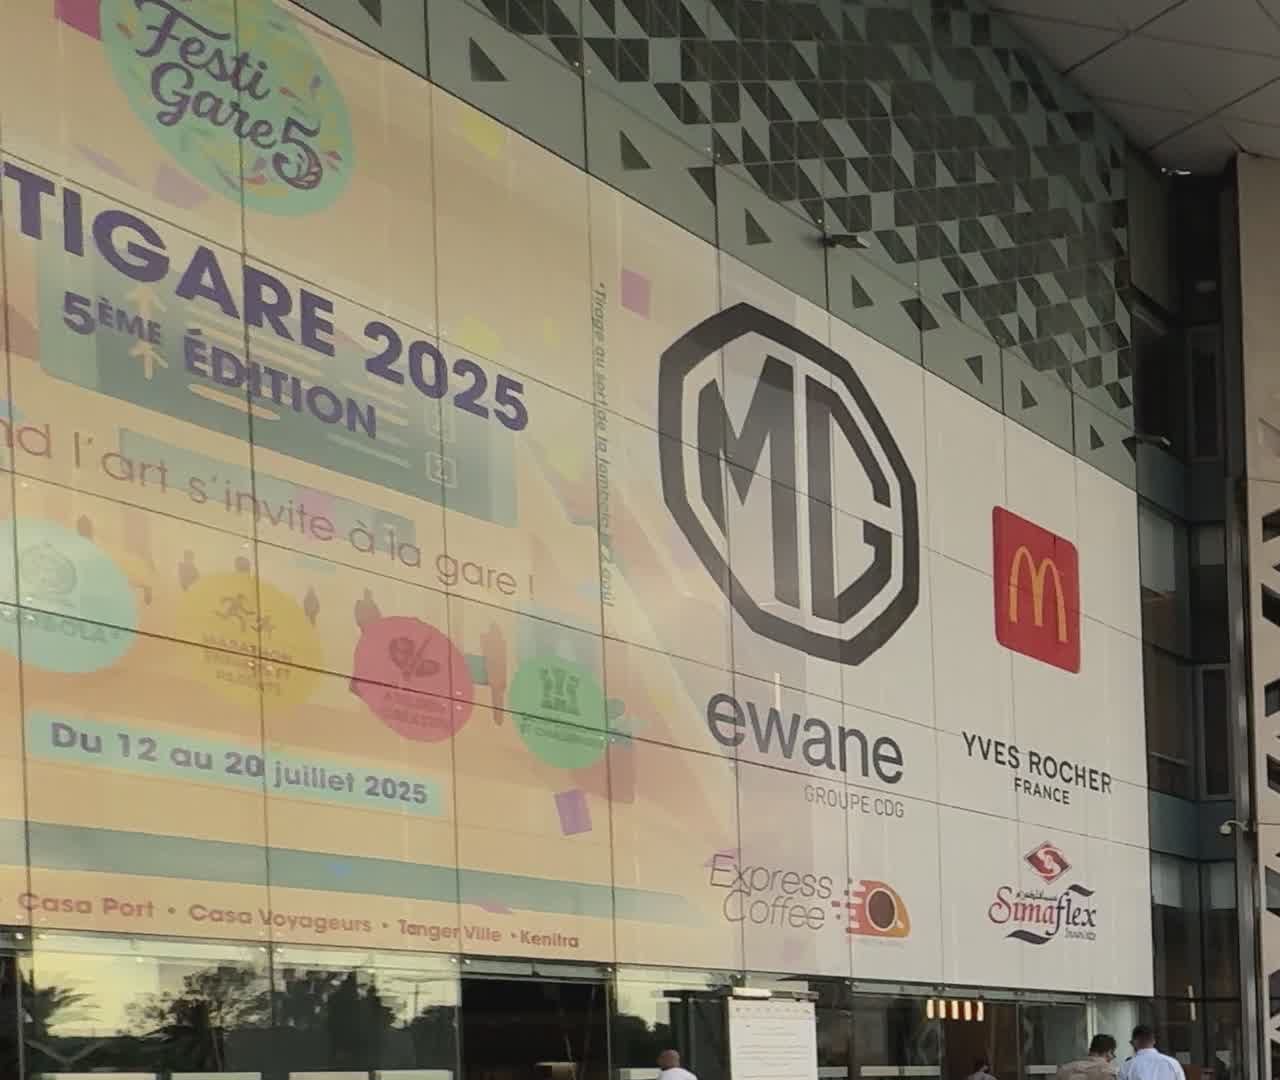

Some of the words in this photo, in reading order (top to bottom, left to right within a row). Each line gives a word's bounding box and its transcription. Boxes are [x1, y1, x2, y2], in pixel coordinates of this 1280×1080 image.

[183, 328, 378, 439] ÉDITION
[364, 320, 529, 432] 2025
[699, 353, 893, 625] MG
[188, 474, 336, 542] s'invite
[349, 519, 376, 556] à
[386, 528, 422, 569] la
[435, 554, 518, 596] gare
[50, 721, 103, 754] Du
[116, 732, 158, 762] 12
[169, 746, 214, 771] au
[224, 751, 265, 778] 20
[273, 760, 355, 794] juillet
[365, 774, 428, 804] 2025
[706, 691, 905, 785] ewane
[962, 731, 1021, 771] YVES
[1028, 737, 1113, 794] ROCHER
[803, 783, 871, 816] GROUPE
[874, 797, 905, 819] CDG
[1014, 777, 1071, 806] FRANCE
[709, 853, 833, 900] Express
[17, 892, 93, 914] Casa
[102, 897, 154, 919] Port
[188, 903, 252, 925] Casa
[258, 908, 372, 934] Voyageurs
[399, 918, 460, 942] Tanger
[463, 923, 502, 942] Ville
[520, 929, 580, 949] Kenitra
[723, 888, 825, 930] Coffee
[988, 885, 1097, 936] Simaflex
